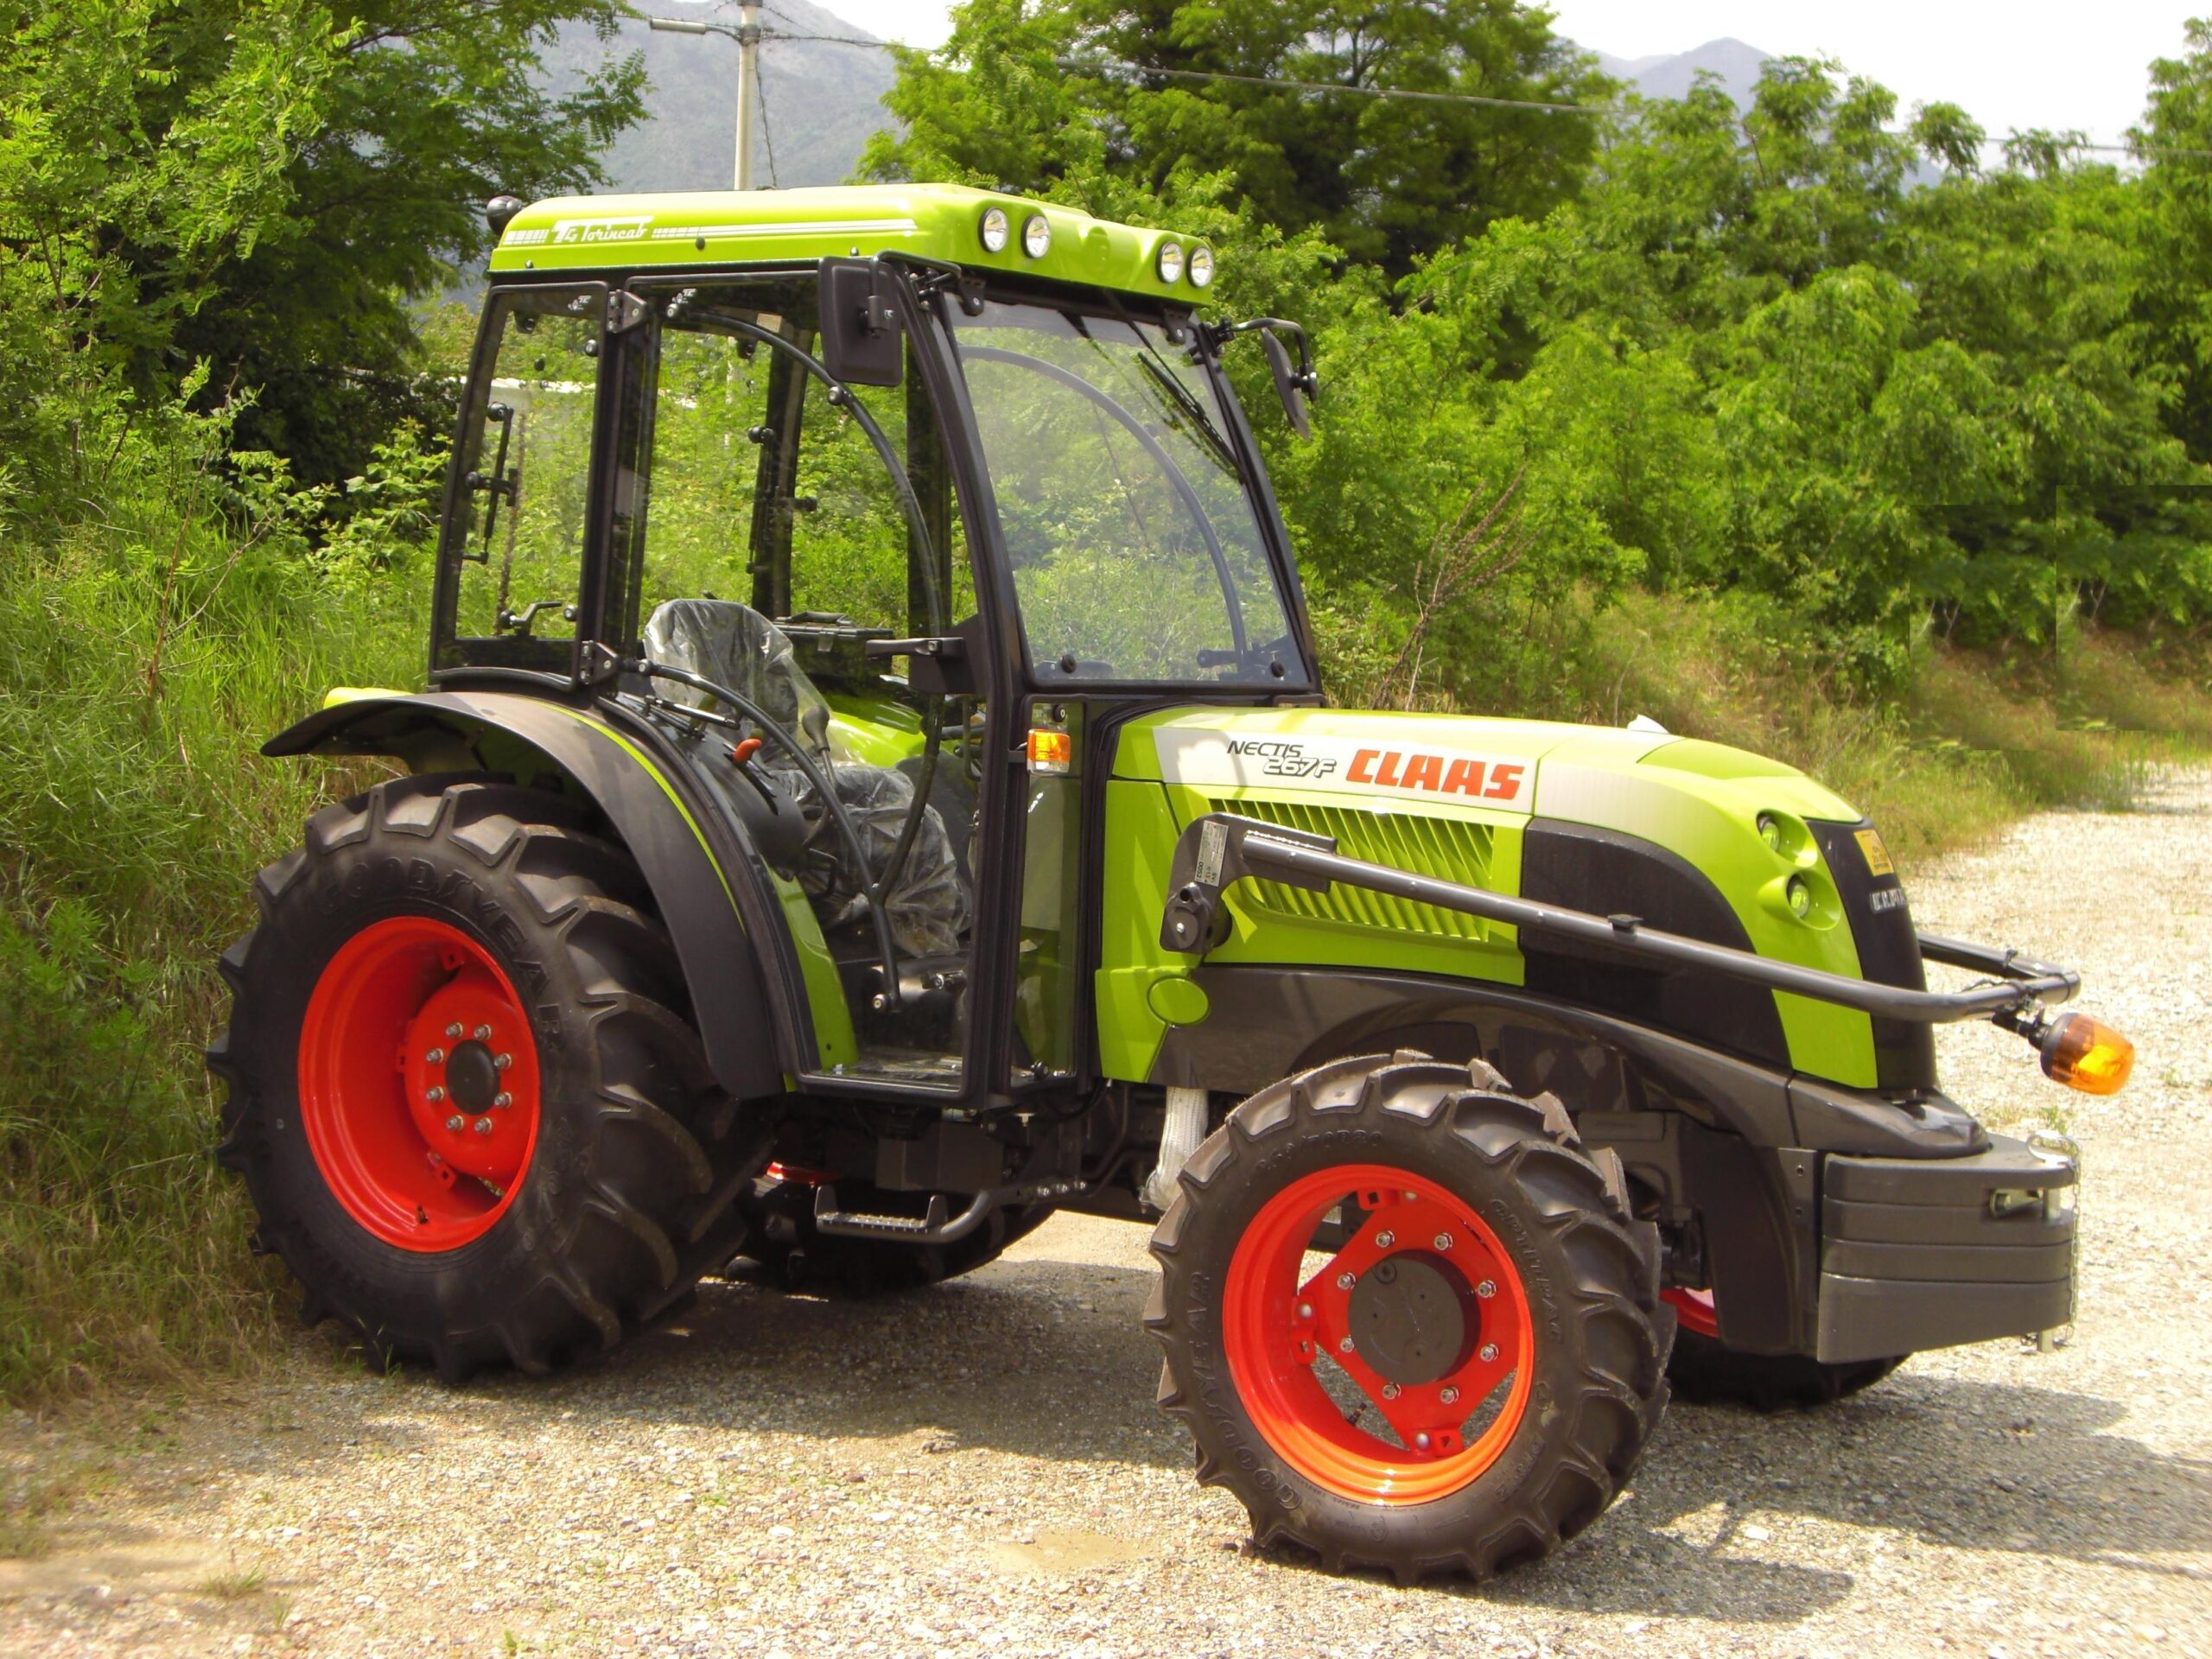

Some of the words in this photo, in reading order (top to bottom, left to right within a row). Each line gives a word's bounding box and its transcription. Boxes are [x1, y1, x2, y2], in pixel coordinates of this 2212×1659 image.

[1226, 740, 1304, 759] NECTIS
[1262, 755, 1337, 779] 267F
[1345, 748, 1525, 800] CLAAS
[321, 856, 565, 1053] GOODYEAR
[1187, 1272, 1301, 1510] GOODYEAR
